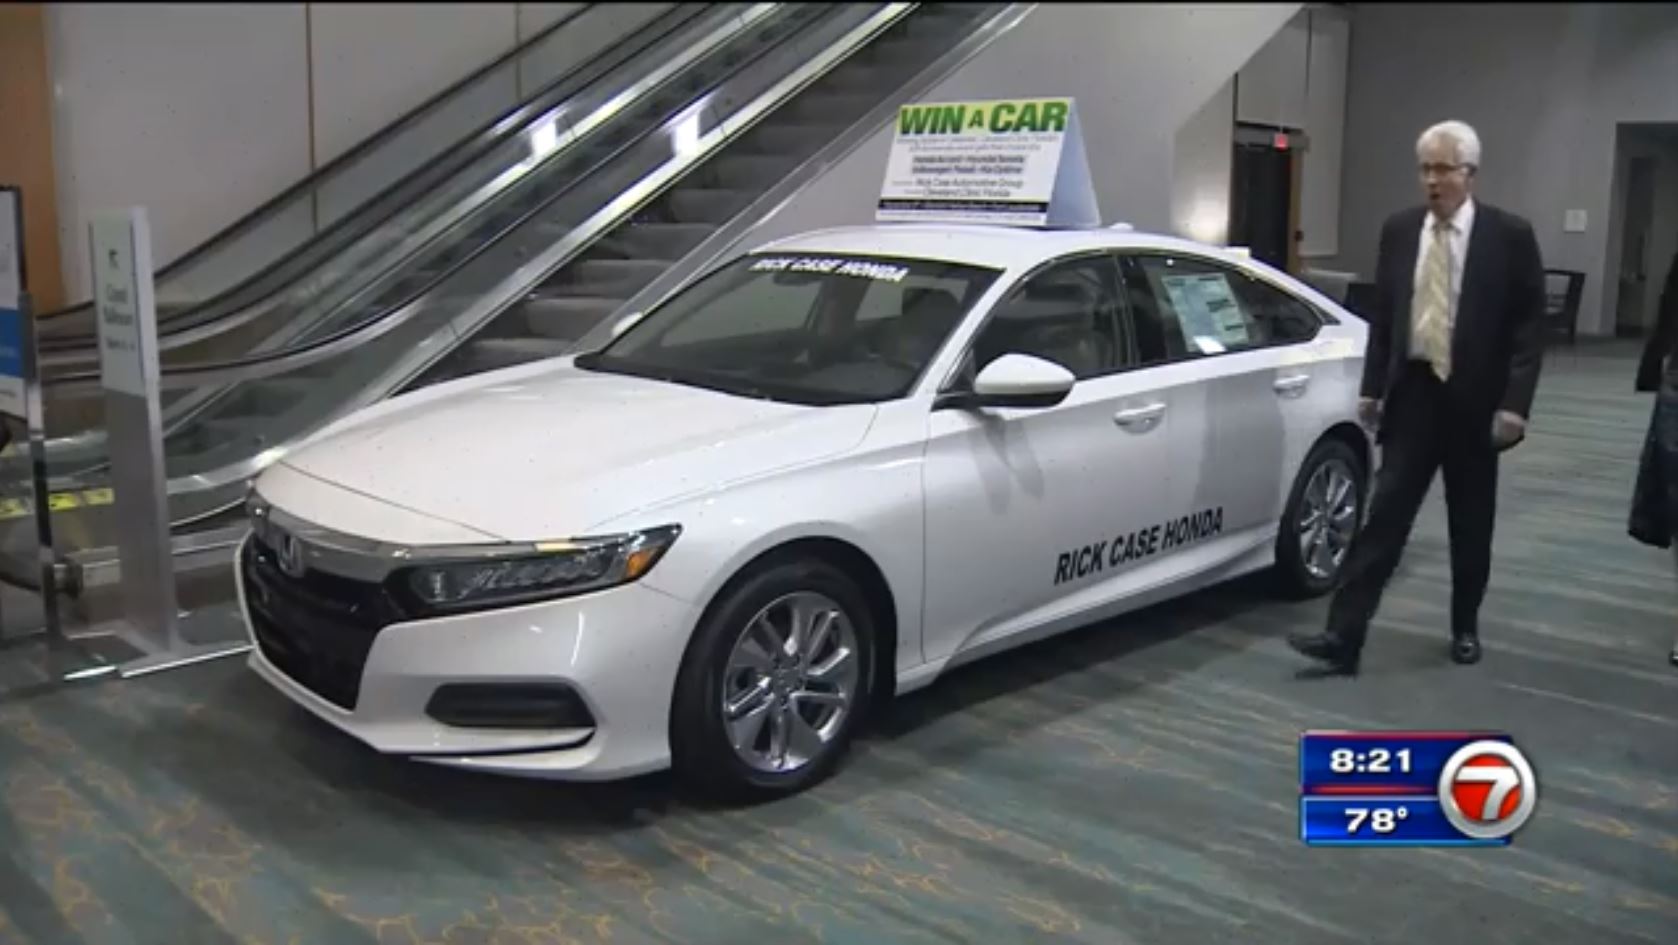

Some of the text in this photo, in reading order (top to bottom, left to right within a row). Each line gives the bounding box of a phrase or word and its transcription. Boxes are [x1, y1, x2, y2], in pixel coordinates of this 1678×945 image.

[901, 101, 1068, 134] WIN A CAR
[790, 258, 842, 272] CASE
[836, 261, 910, 282] HONDA
[1054, 506, 1223, 585] RICK CASE HONDA
